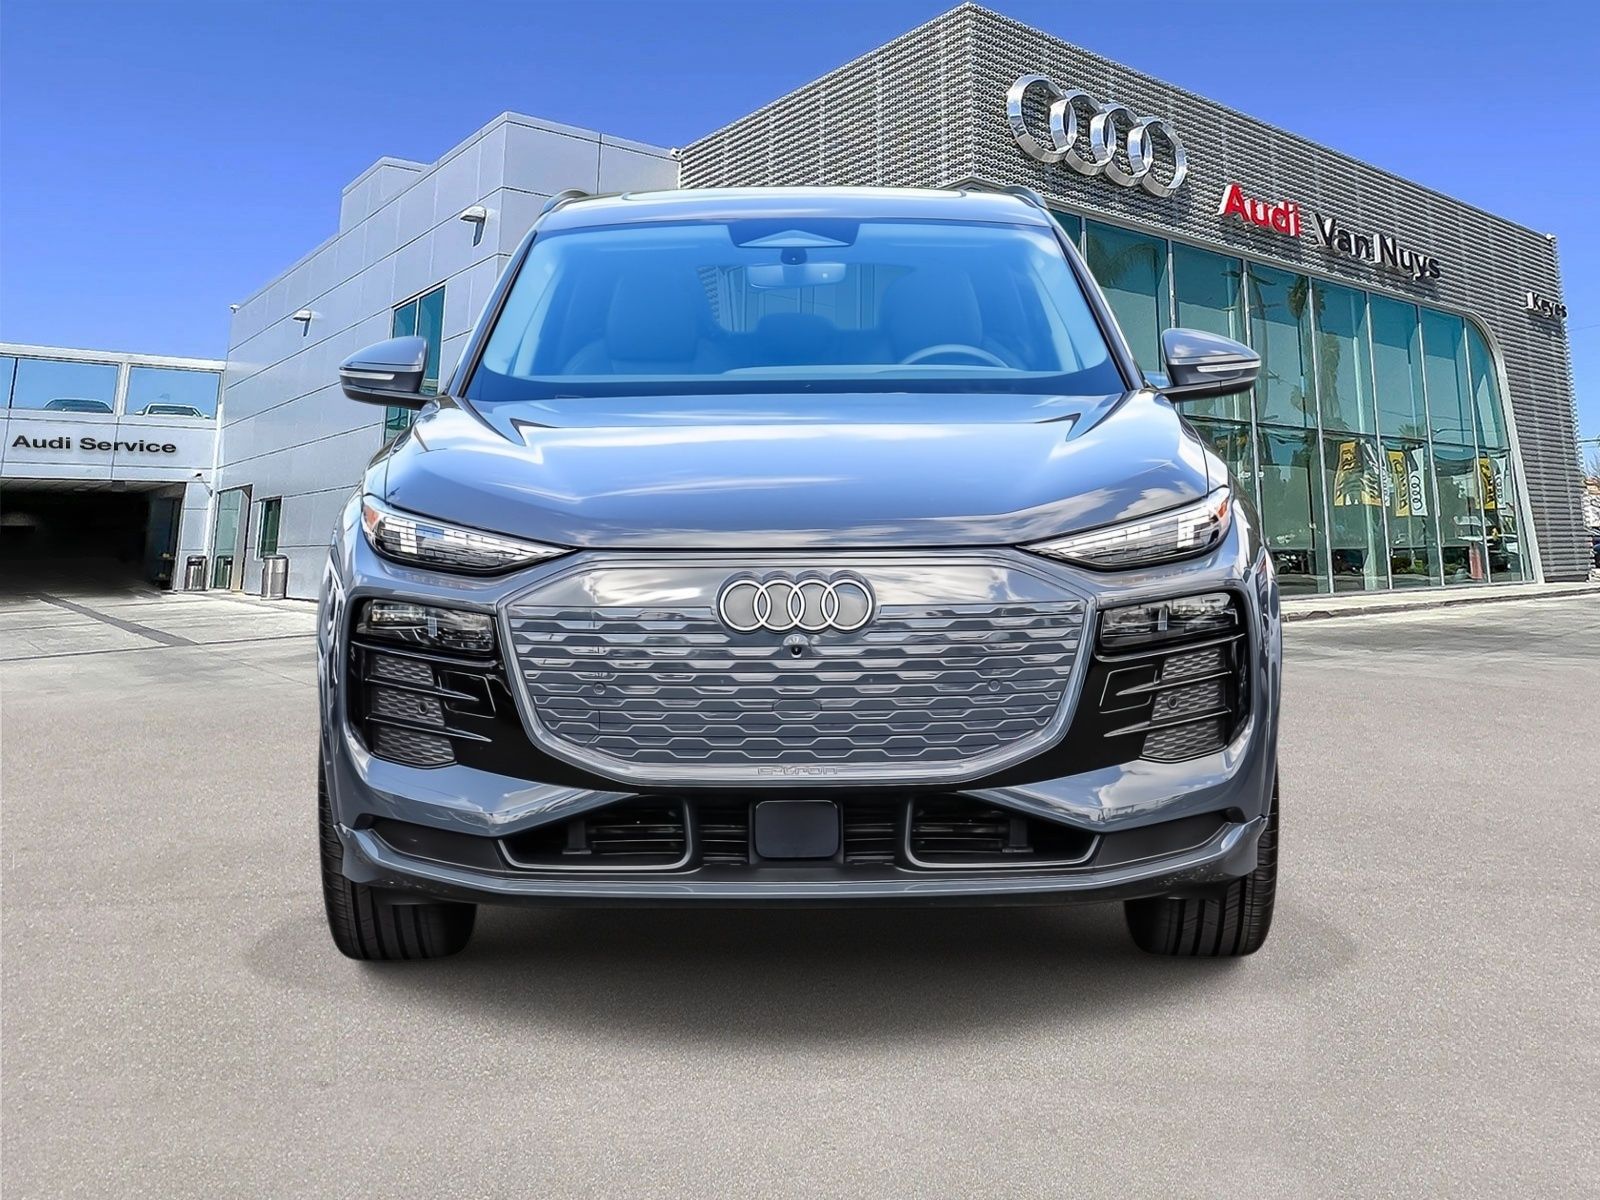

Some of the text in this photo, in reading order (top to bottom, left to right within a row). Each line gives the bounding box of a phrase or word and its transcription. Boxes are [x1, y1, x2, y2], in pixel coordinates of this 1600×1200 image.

[1218, 182, 1442, 281] Audi Van Nuys
[1526, 291, 1568, 319] Keyes
[12, 435, 177, 454] Audi Service
